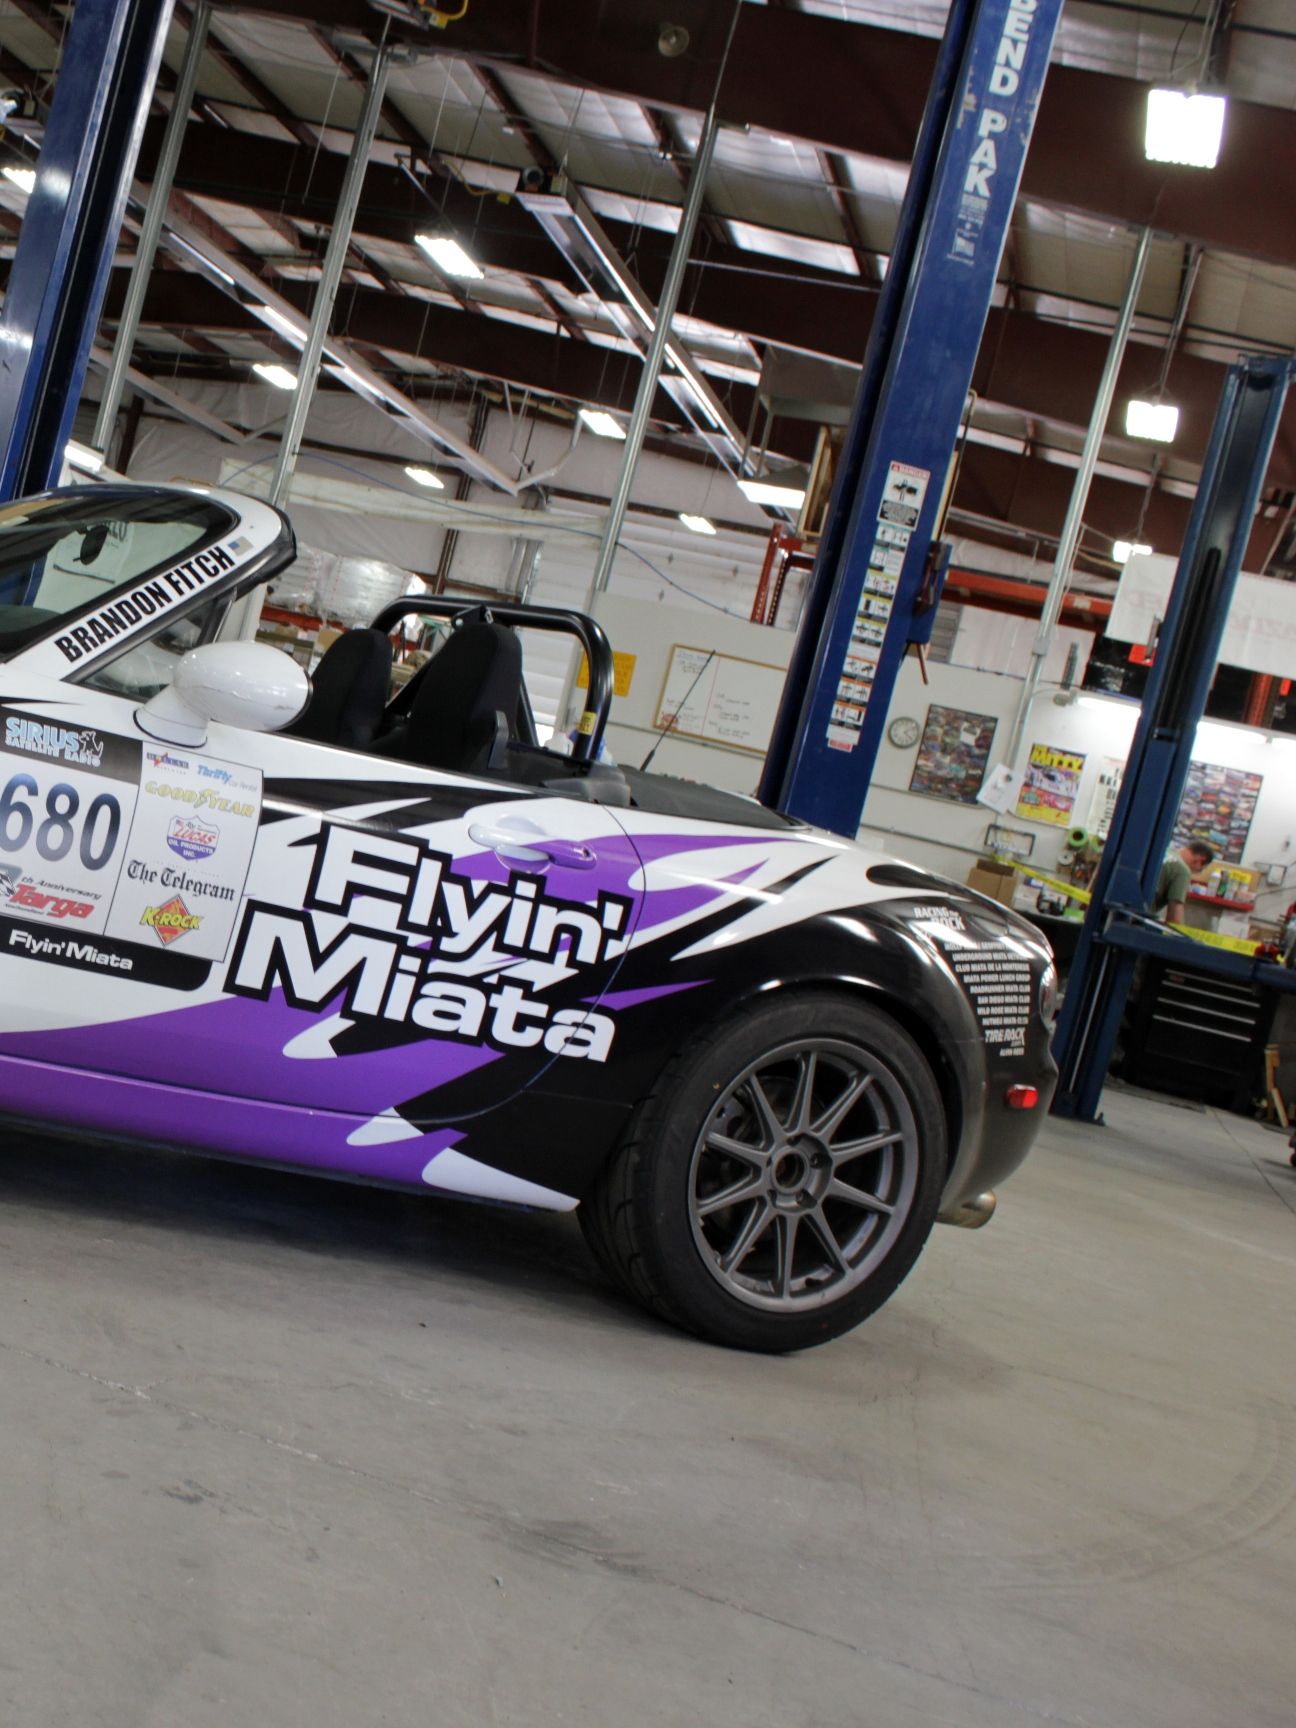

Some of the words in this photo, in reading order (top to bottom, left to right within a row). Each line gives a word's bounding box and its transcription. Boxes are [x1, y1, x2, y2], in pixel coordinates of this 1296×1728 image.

[963, 108, 1007, 198] PAK
[54, 581, 171, 663] BRANDON
[163, 545, 236, 596] FITCH
[5, 716, 80, 752] SIRIUS
[197, 764, 232, 785] Thrifty
[181, 841, 215, 854] PRODUCTS
[37, 879, 103, 901] Anniversary
[127, 860, 158, 884] The
[161, 867, 235, 900] Telegram
[314, 826, 624, 965] Flyin'
[9, 884, 95, 918] Targa
[914, 907, 947, 918] RACING
[9, 929, 65, 955] Flyin'
[66, 942, 133, 970] Miata
[964, 974, 980, 983] MIATA
[971, 963, 987, 972] MIATA
[235, 910, 615, 1062] Miata
[985, 1029, 1004, 1043] TIRE
[1004, 1027, 1026, 1046] RACK
